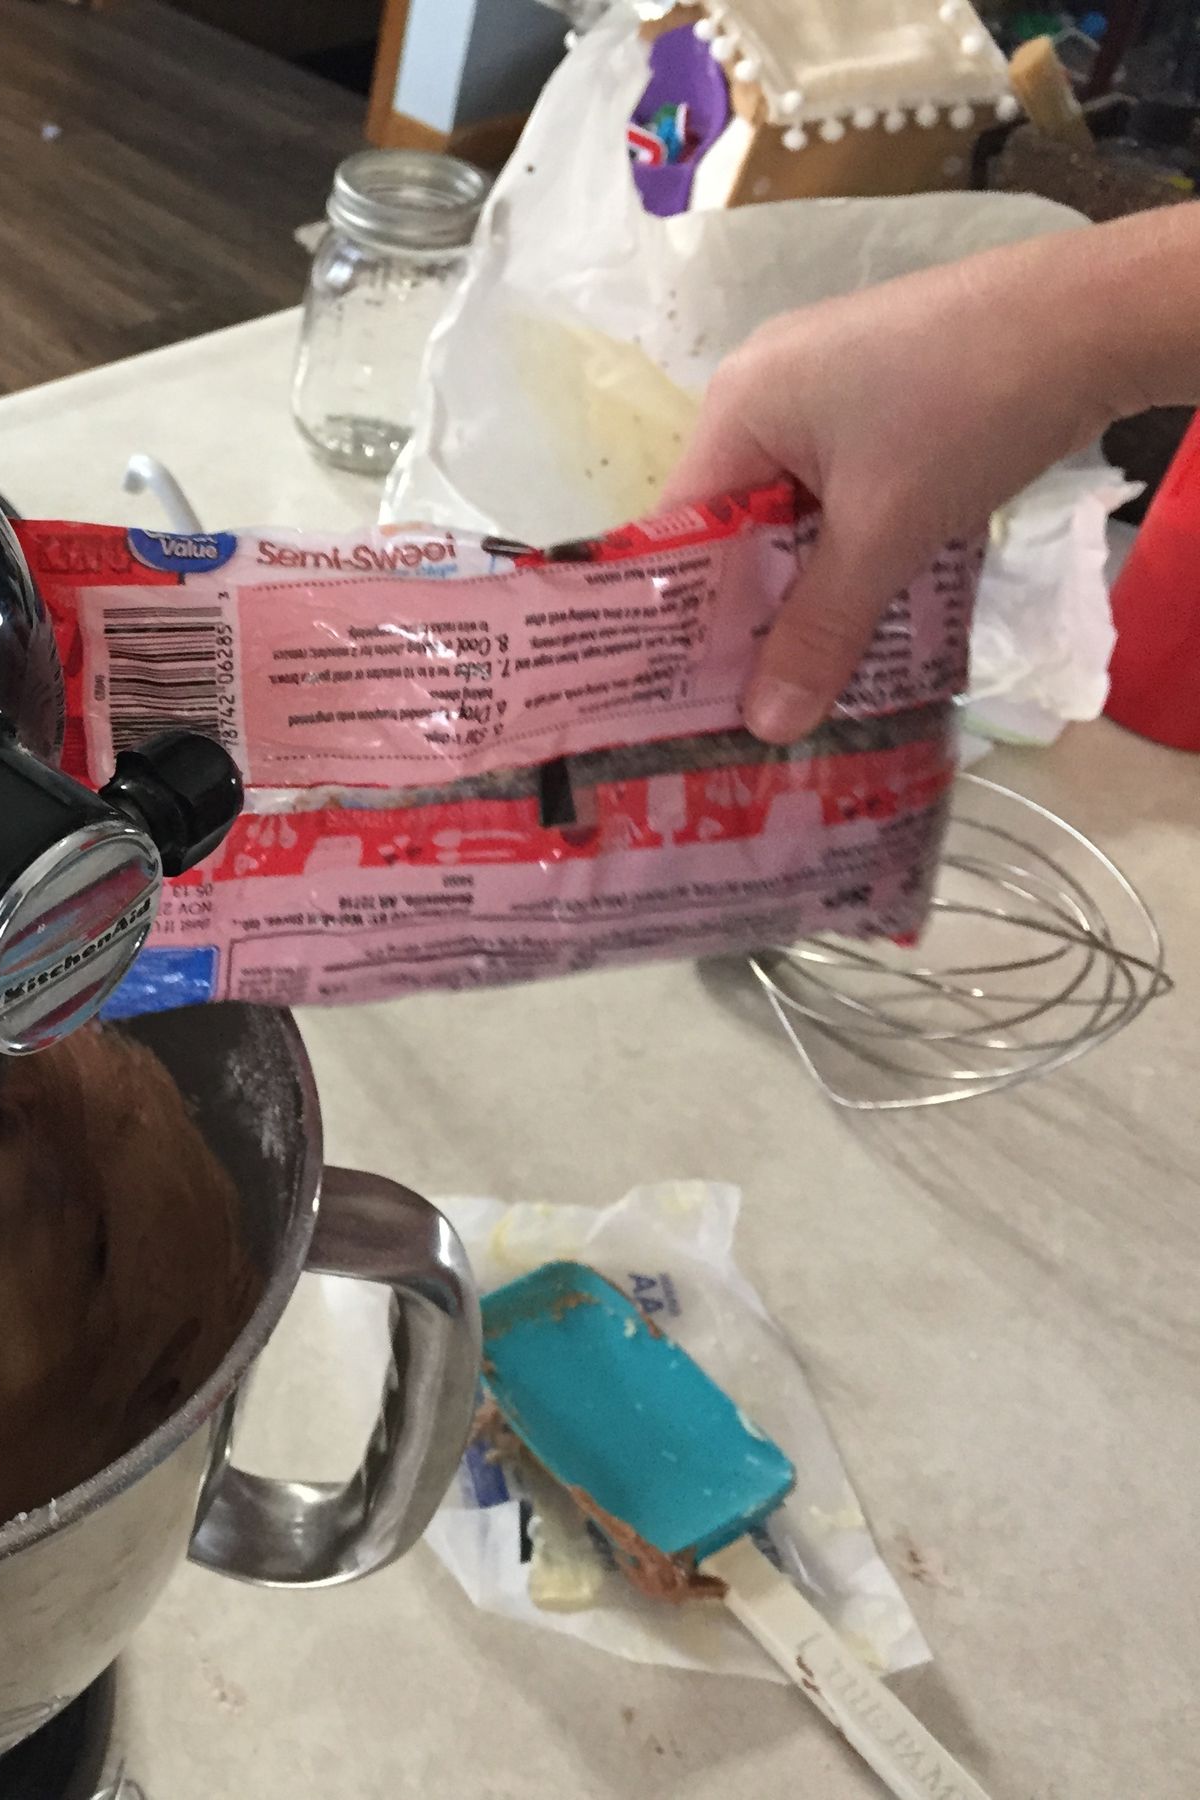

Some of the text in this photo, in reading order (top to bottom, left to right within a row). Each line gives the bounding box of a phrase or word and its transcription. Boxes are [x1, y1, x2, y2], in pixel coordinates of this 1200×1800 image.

[159, 537, 218, 560] Value
[216, 624, 235, 685] 06285
[456, 637, 491, 658] Cool
[180, 902, 213, 916] NOV
[3, 898, 151, 1003] KitchenAid
